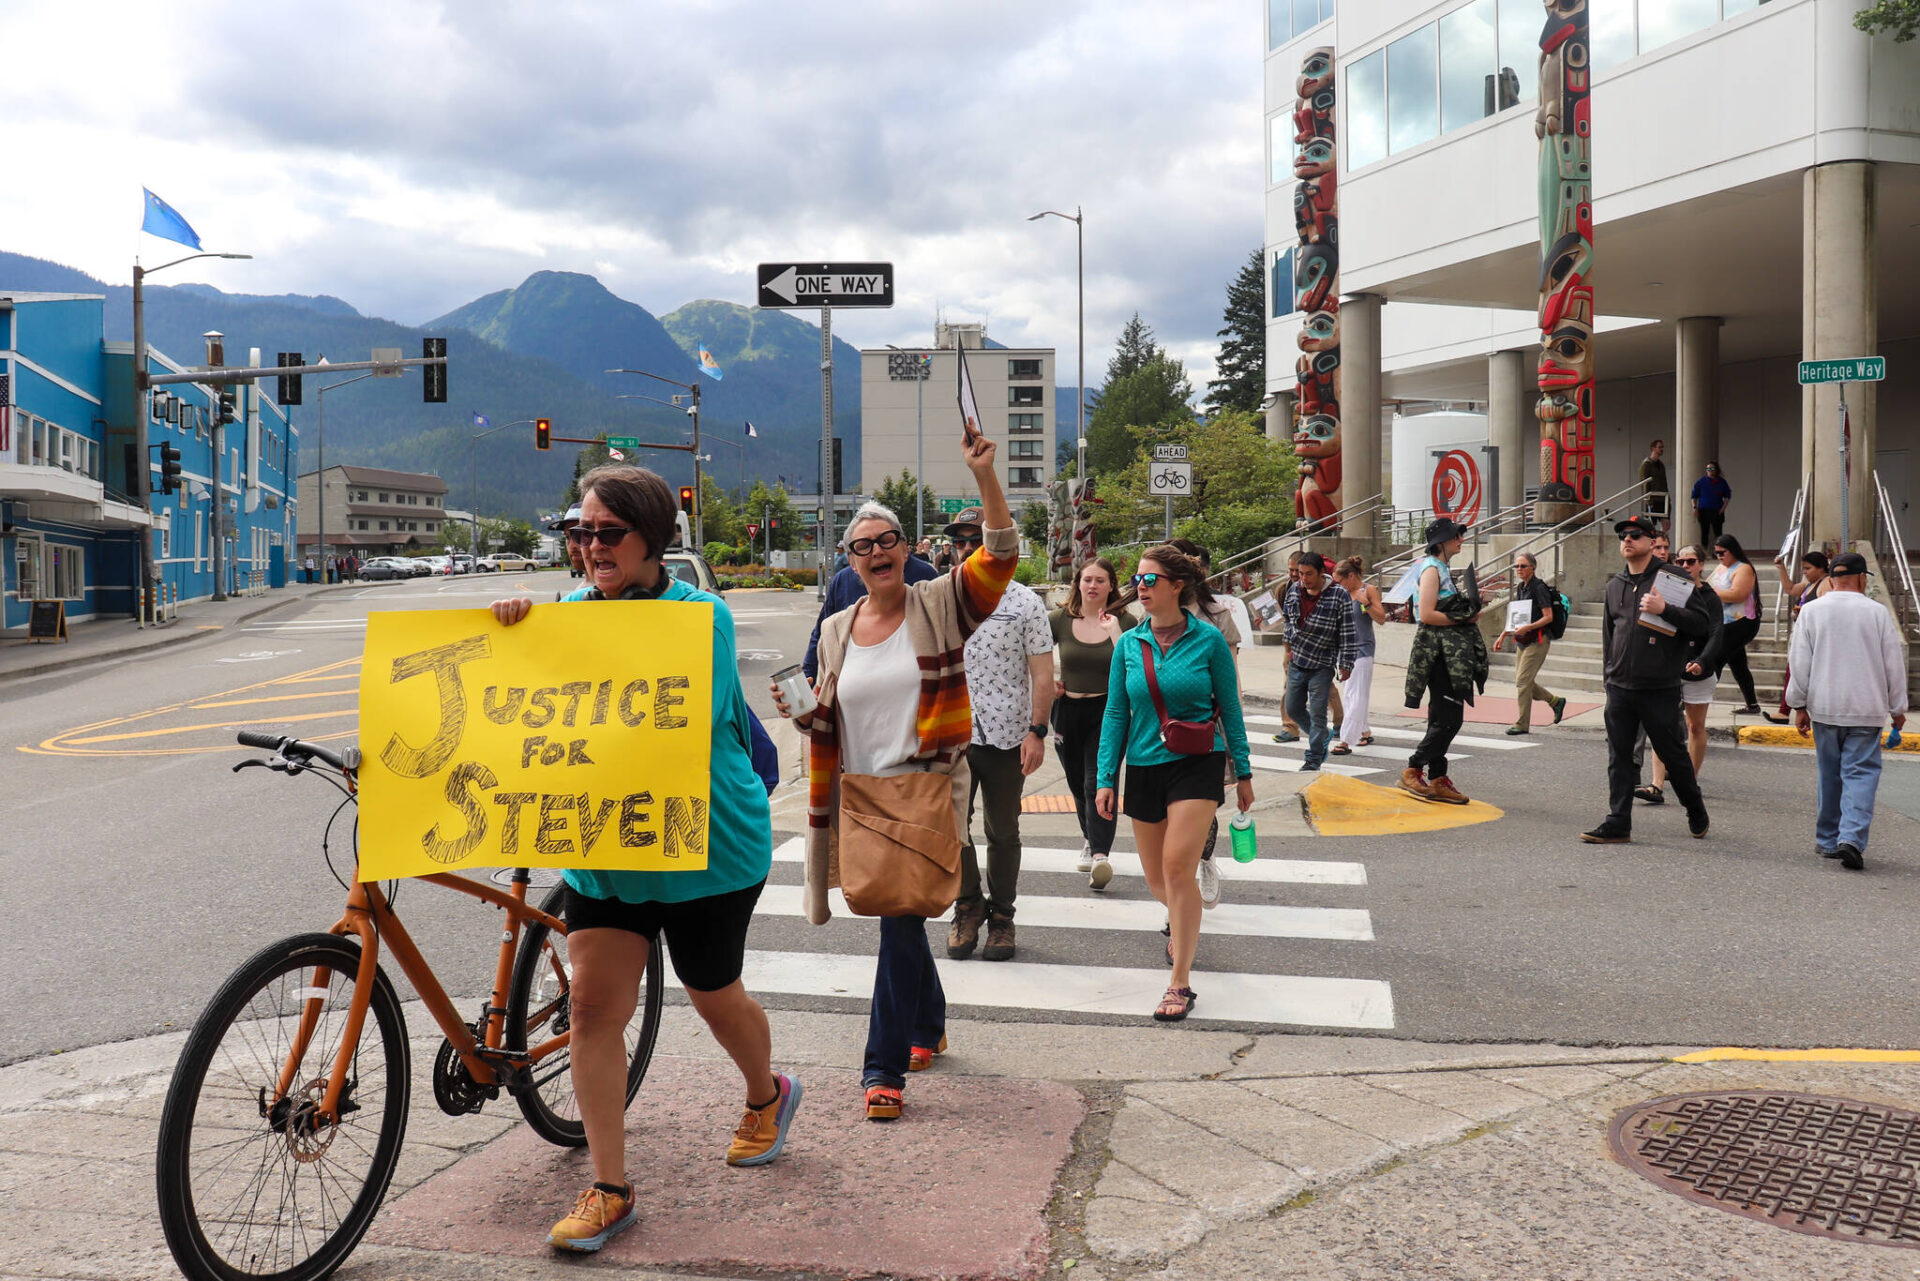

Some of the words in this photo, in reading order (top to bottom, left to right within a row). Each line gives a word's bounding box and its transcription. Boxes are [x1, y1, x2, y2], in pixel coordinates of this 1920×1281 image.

[796, 276, 832, 293] ONE
[841, 276, 878, 293] WAY
[888, 354, 920, 365] FOUR
[1801, 364, 1853, 380] Heritage
[1856, 361, 1882, 379] Way
[1158, 447, 1185, 456] AHEAD
[379, 633, 690, 779] JUSTICE
[421, 760, 707, 864] STEVEN
